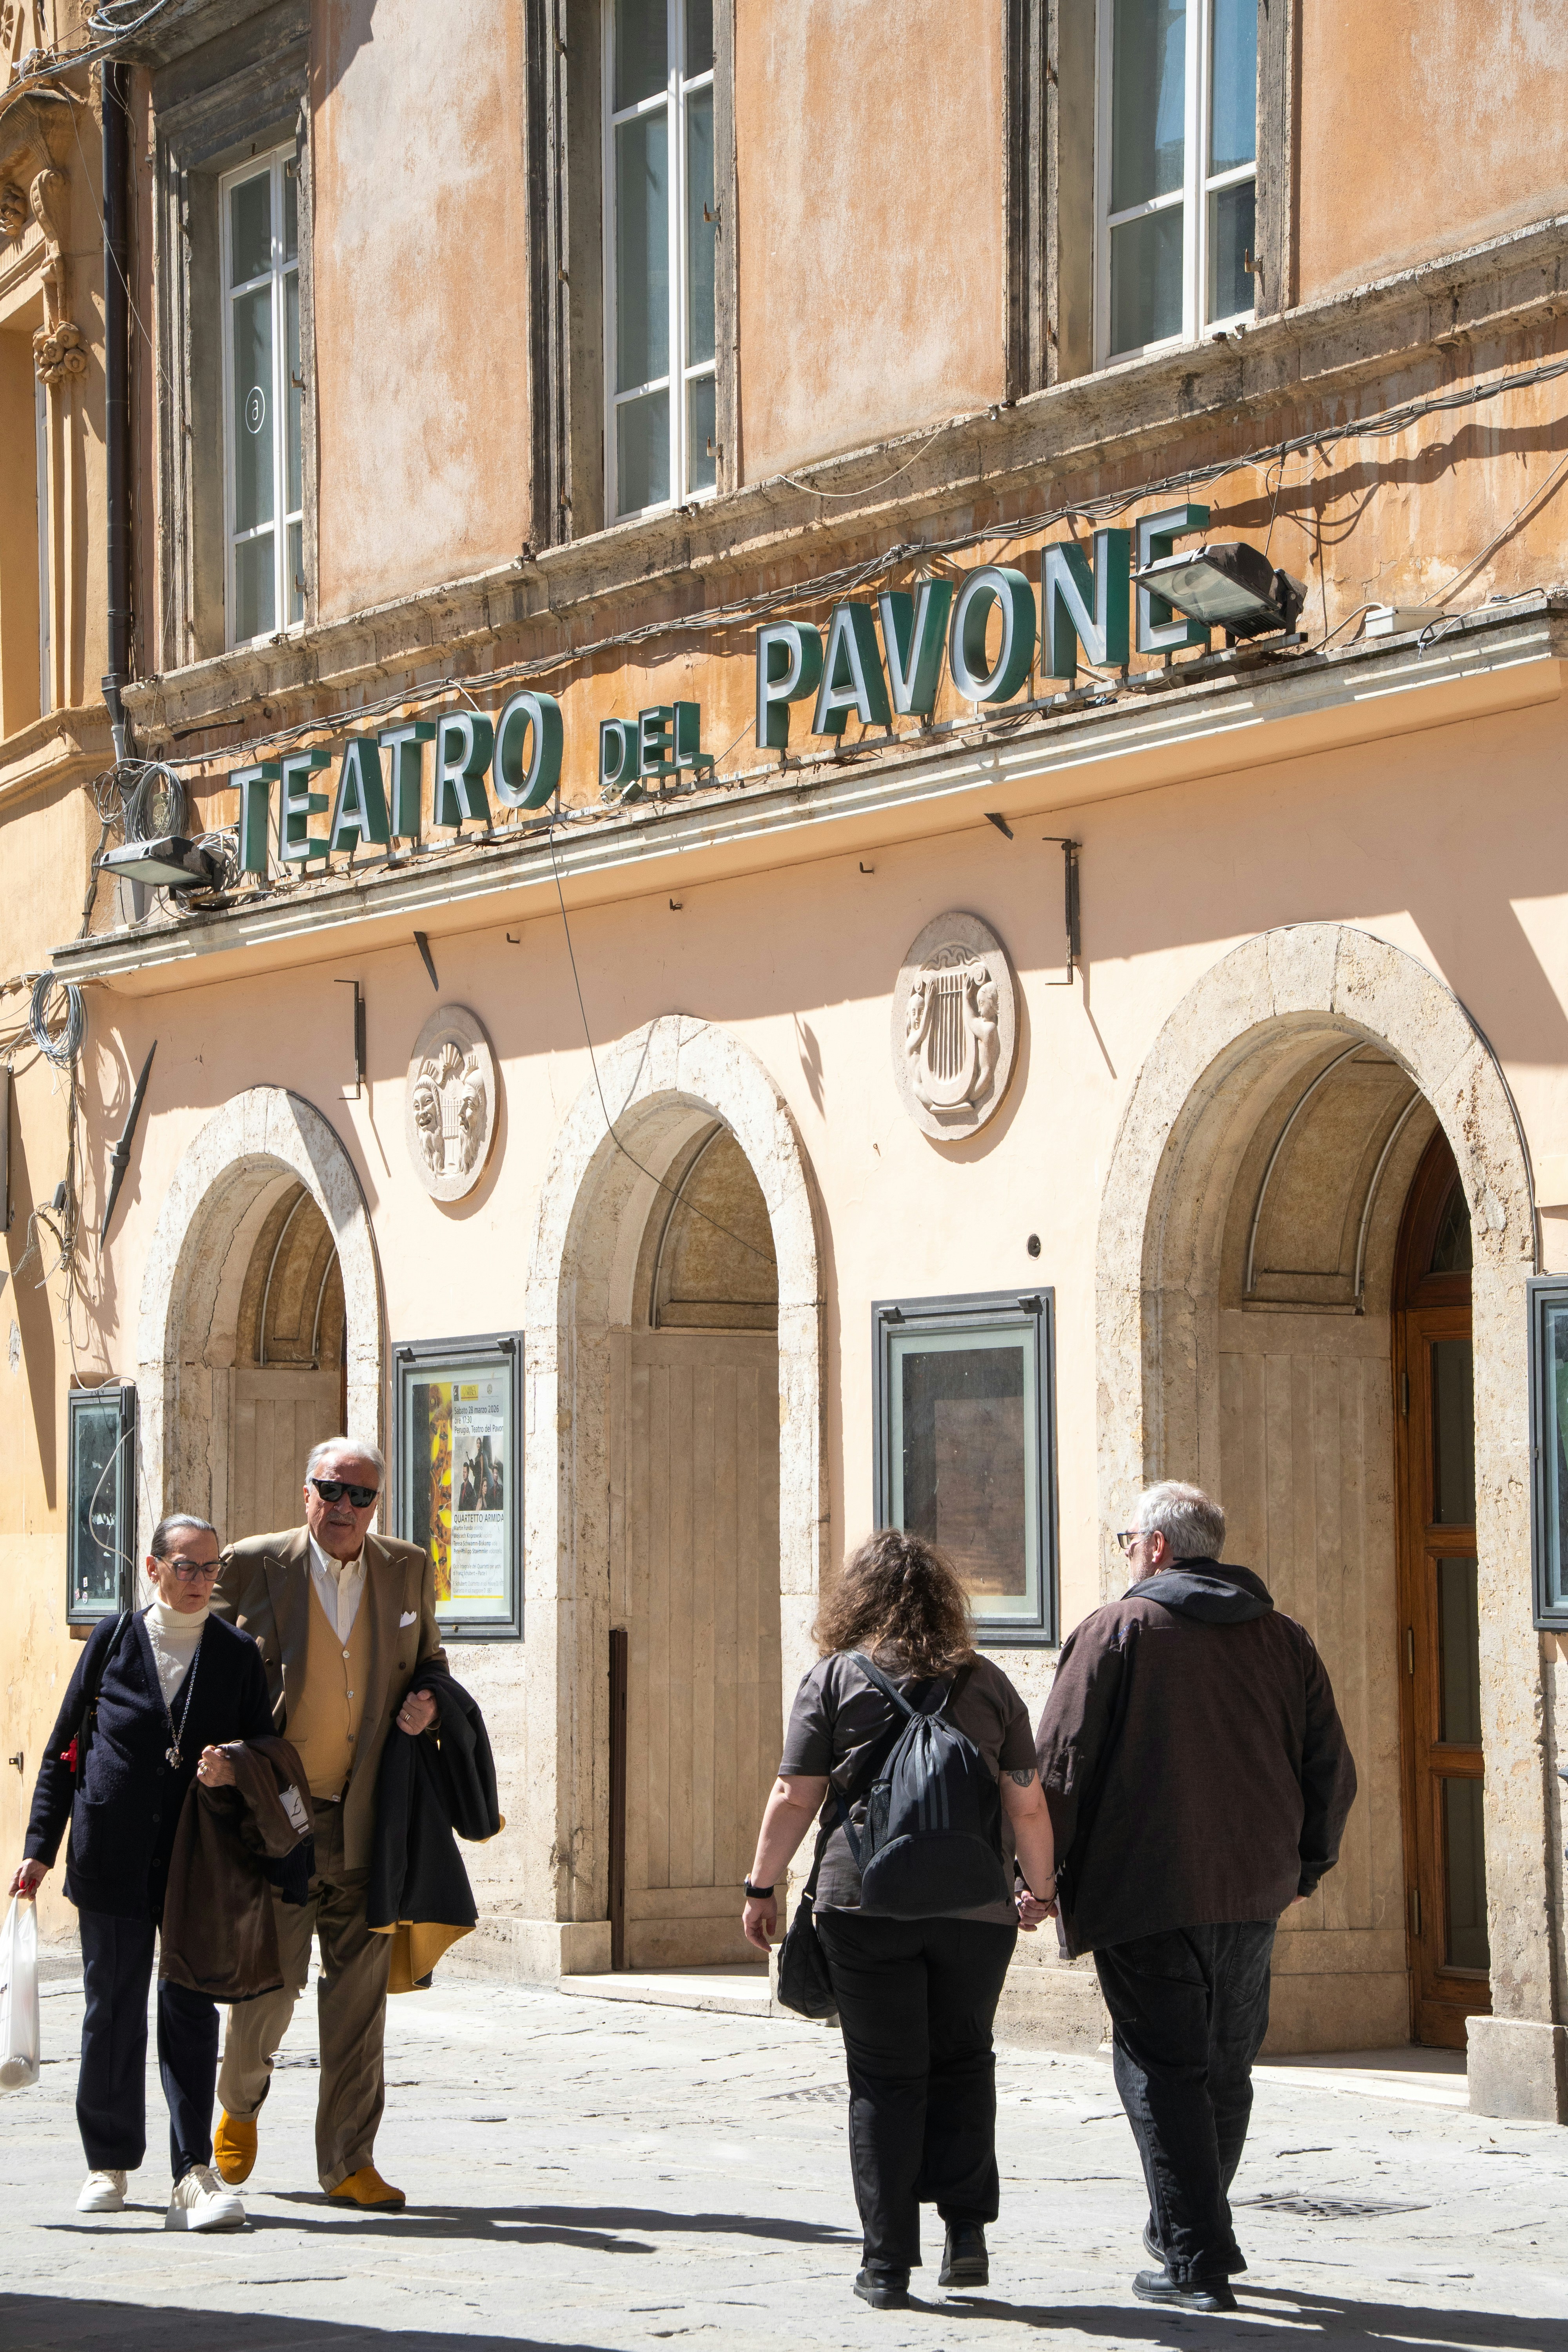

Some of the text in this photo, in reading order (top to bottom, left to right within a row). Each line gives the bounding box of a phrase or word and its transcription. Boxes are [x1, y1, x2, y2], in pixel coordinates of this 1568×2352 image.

[227, 503, 1211, 873] TEATRO DEL PAVONE
[455, 1426, 470, 1435] Perugia,
[454, 1514, 504, 1524] QUARTETTO ARMIDA
